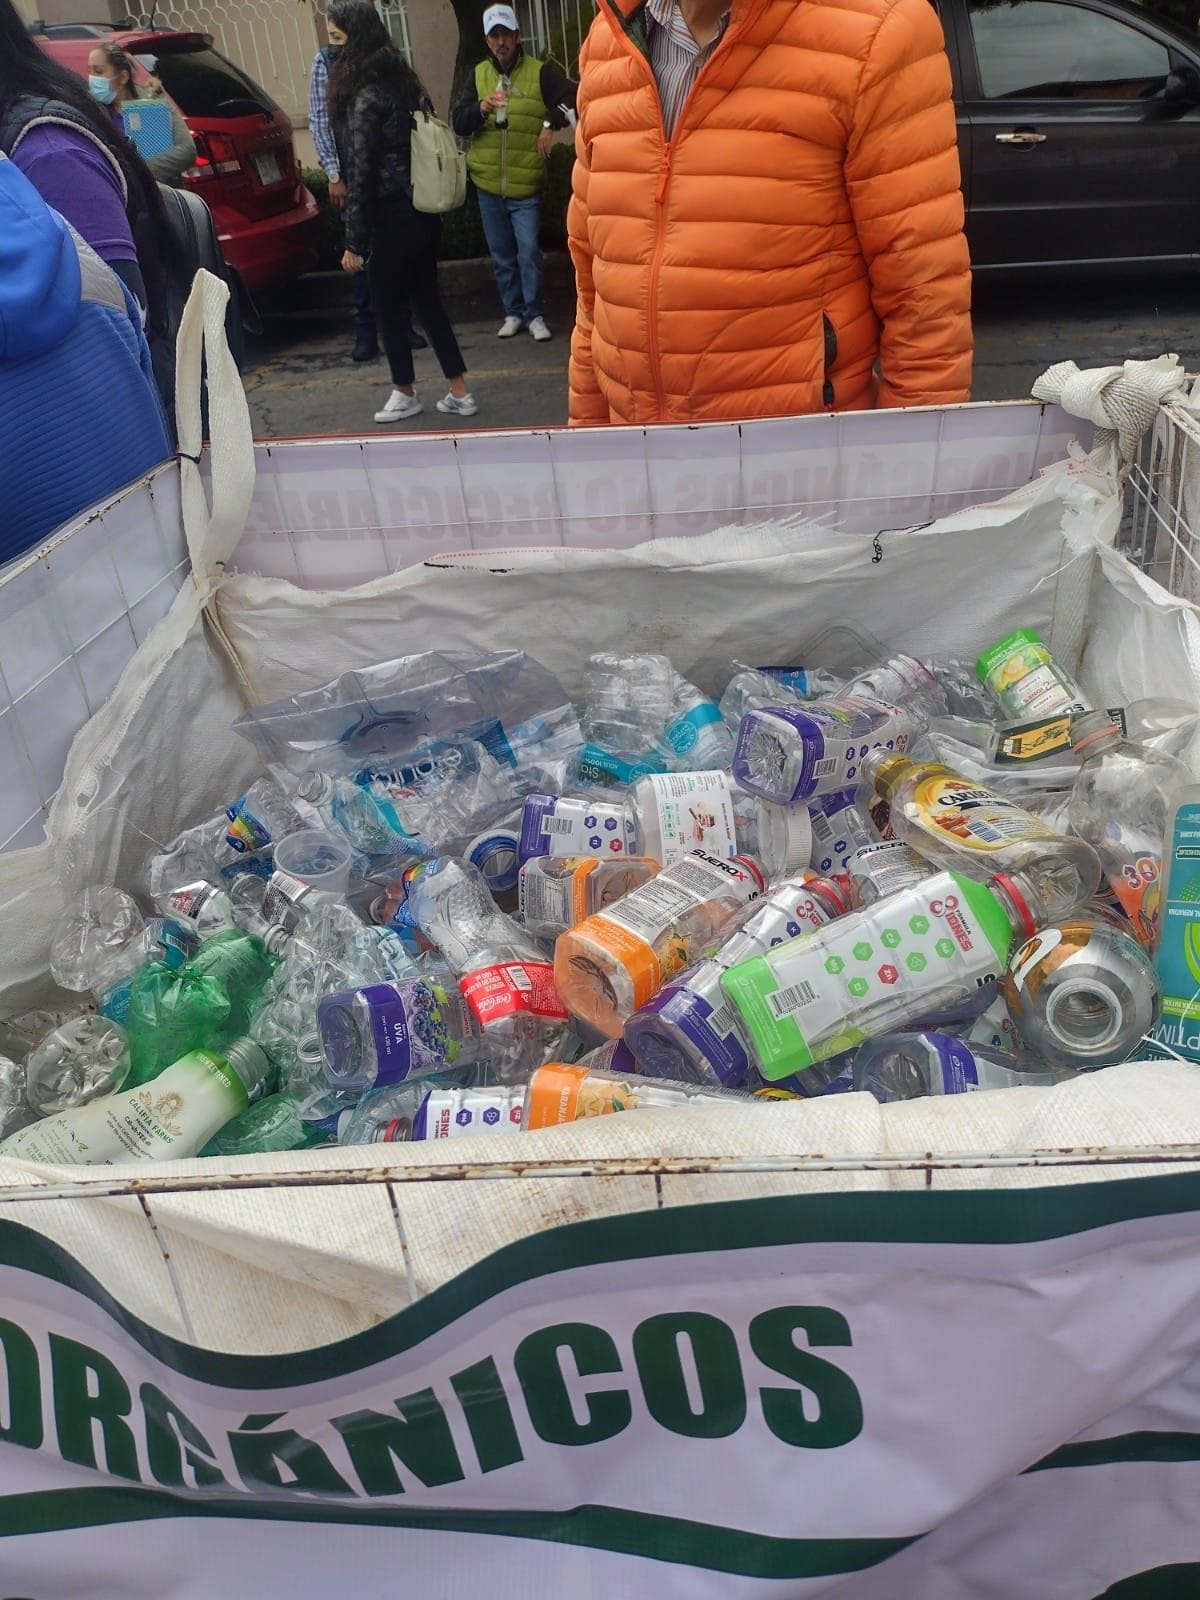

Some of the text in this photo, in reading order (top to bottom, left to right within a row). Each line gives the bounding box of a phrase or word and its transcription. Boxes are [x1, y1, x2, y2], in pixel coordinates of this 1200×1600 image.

[690, 848, 748, 882] SUEROX
[944, 912, 974, 952] IONES
[393, 1023, 404, 1044] UVA
